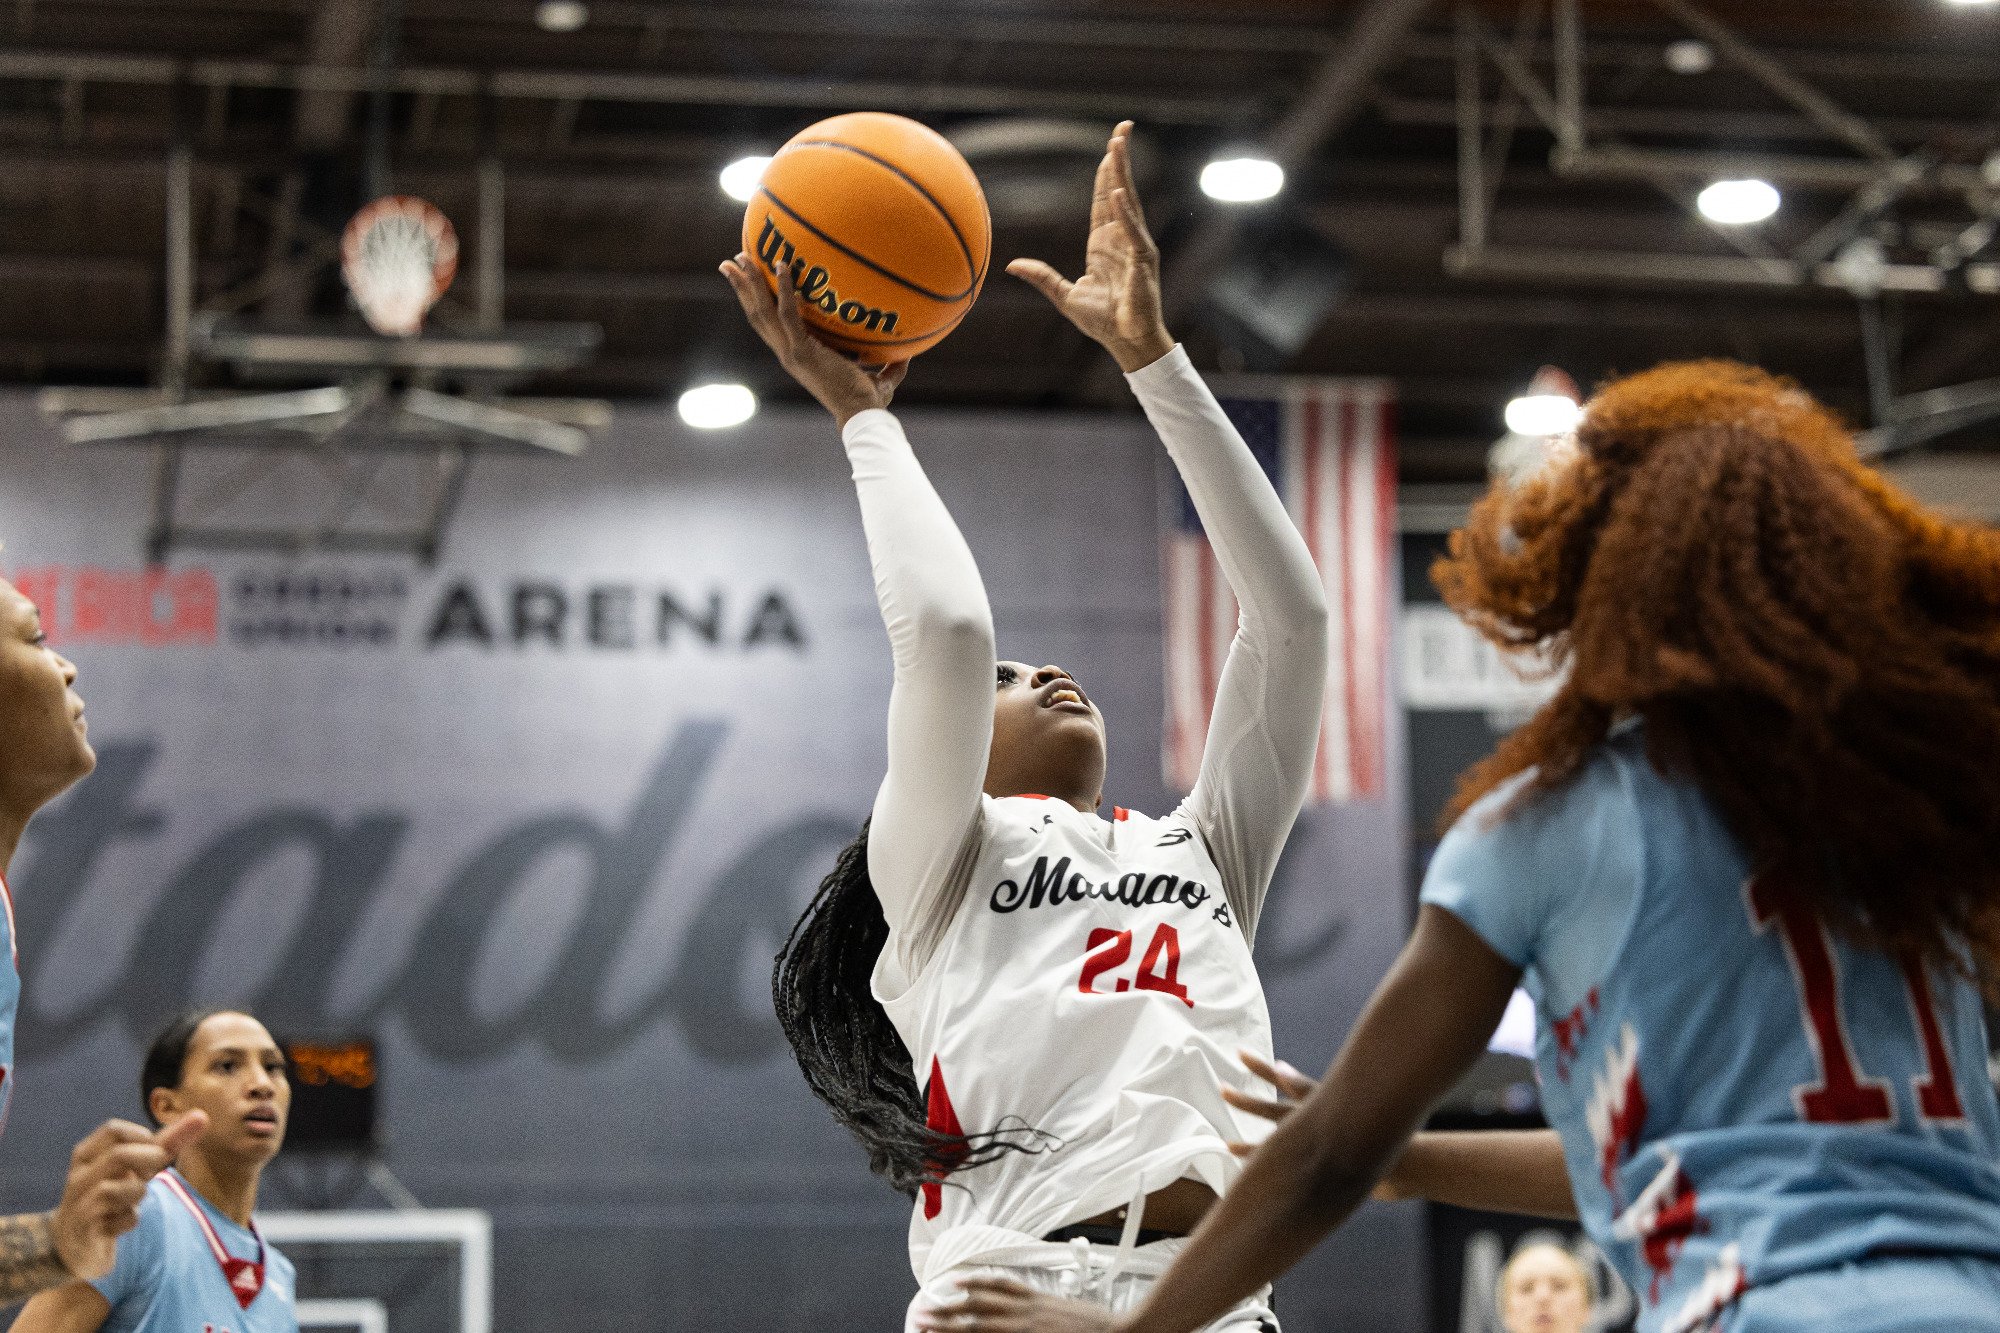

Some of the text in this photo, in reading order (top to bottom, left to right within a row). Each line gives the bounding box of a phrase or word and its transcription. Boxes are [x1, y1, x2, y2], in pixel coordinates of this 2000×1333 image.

[757, 213, 901, 335] Wilson
[425, 576, 811, 652] ARENA
[1078, 922, 1195, 1009] 24
